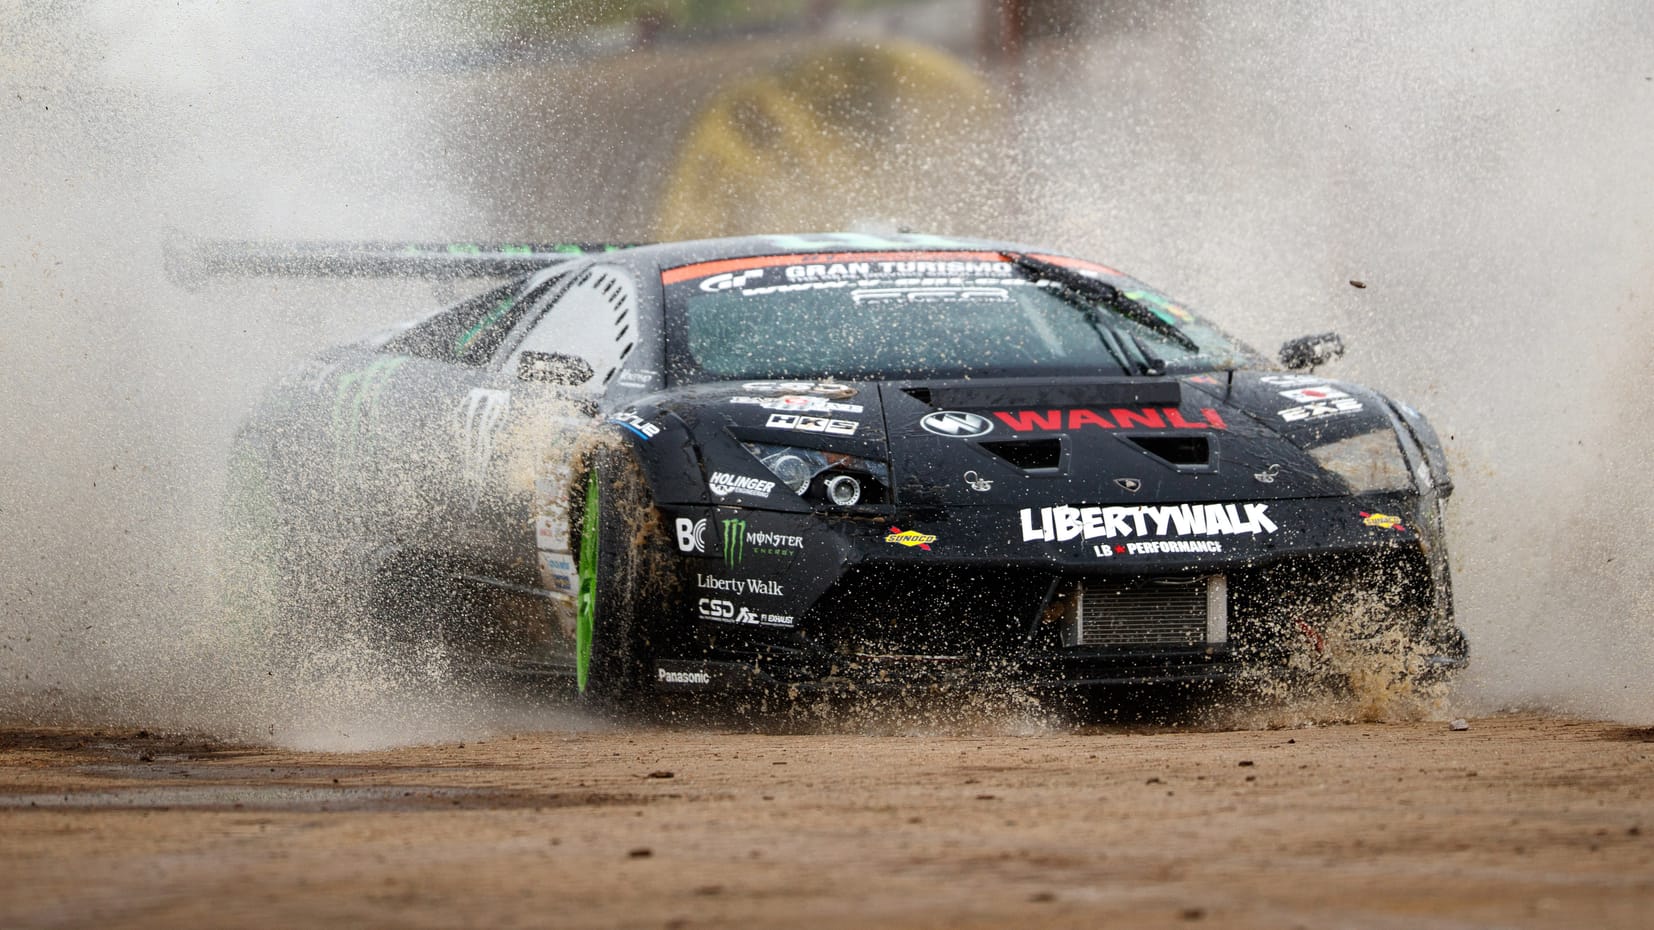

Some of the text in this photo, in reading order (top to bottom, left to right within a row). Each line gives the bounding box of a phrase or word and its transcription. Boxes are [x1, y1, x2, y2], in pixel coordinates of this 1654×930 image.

[785, 262, 869, 278] GRAN
[877, 260, 1013, 274] TURISMO
[765, 413, 859, 436] HKS
[993, 408, 1227, 431] WANLI
[709, 471, 776, 493] HOLINGER
[1020, 503, 1278, 542] LIBERTYWALK
[887, 534, 935, 543] SUNOCO
[752, 547, 795, 556] ENERGY
[1093, 541, 1222, 557] LB PERFORMANCE
[697, 573, 783, 596] Liberty Walk
[699, 598, 734, 618] CSD
[768, 614, 794, 624] EXHAUST
[658, 668, 711, 684] Panasonic
